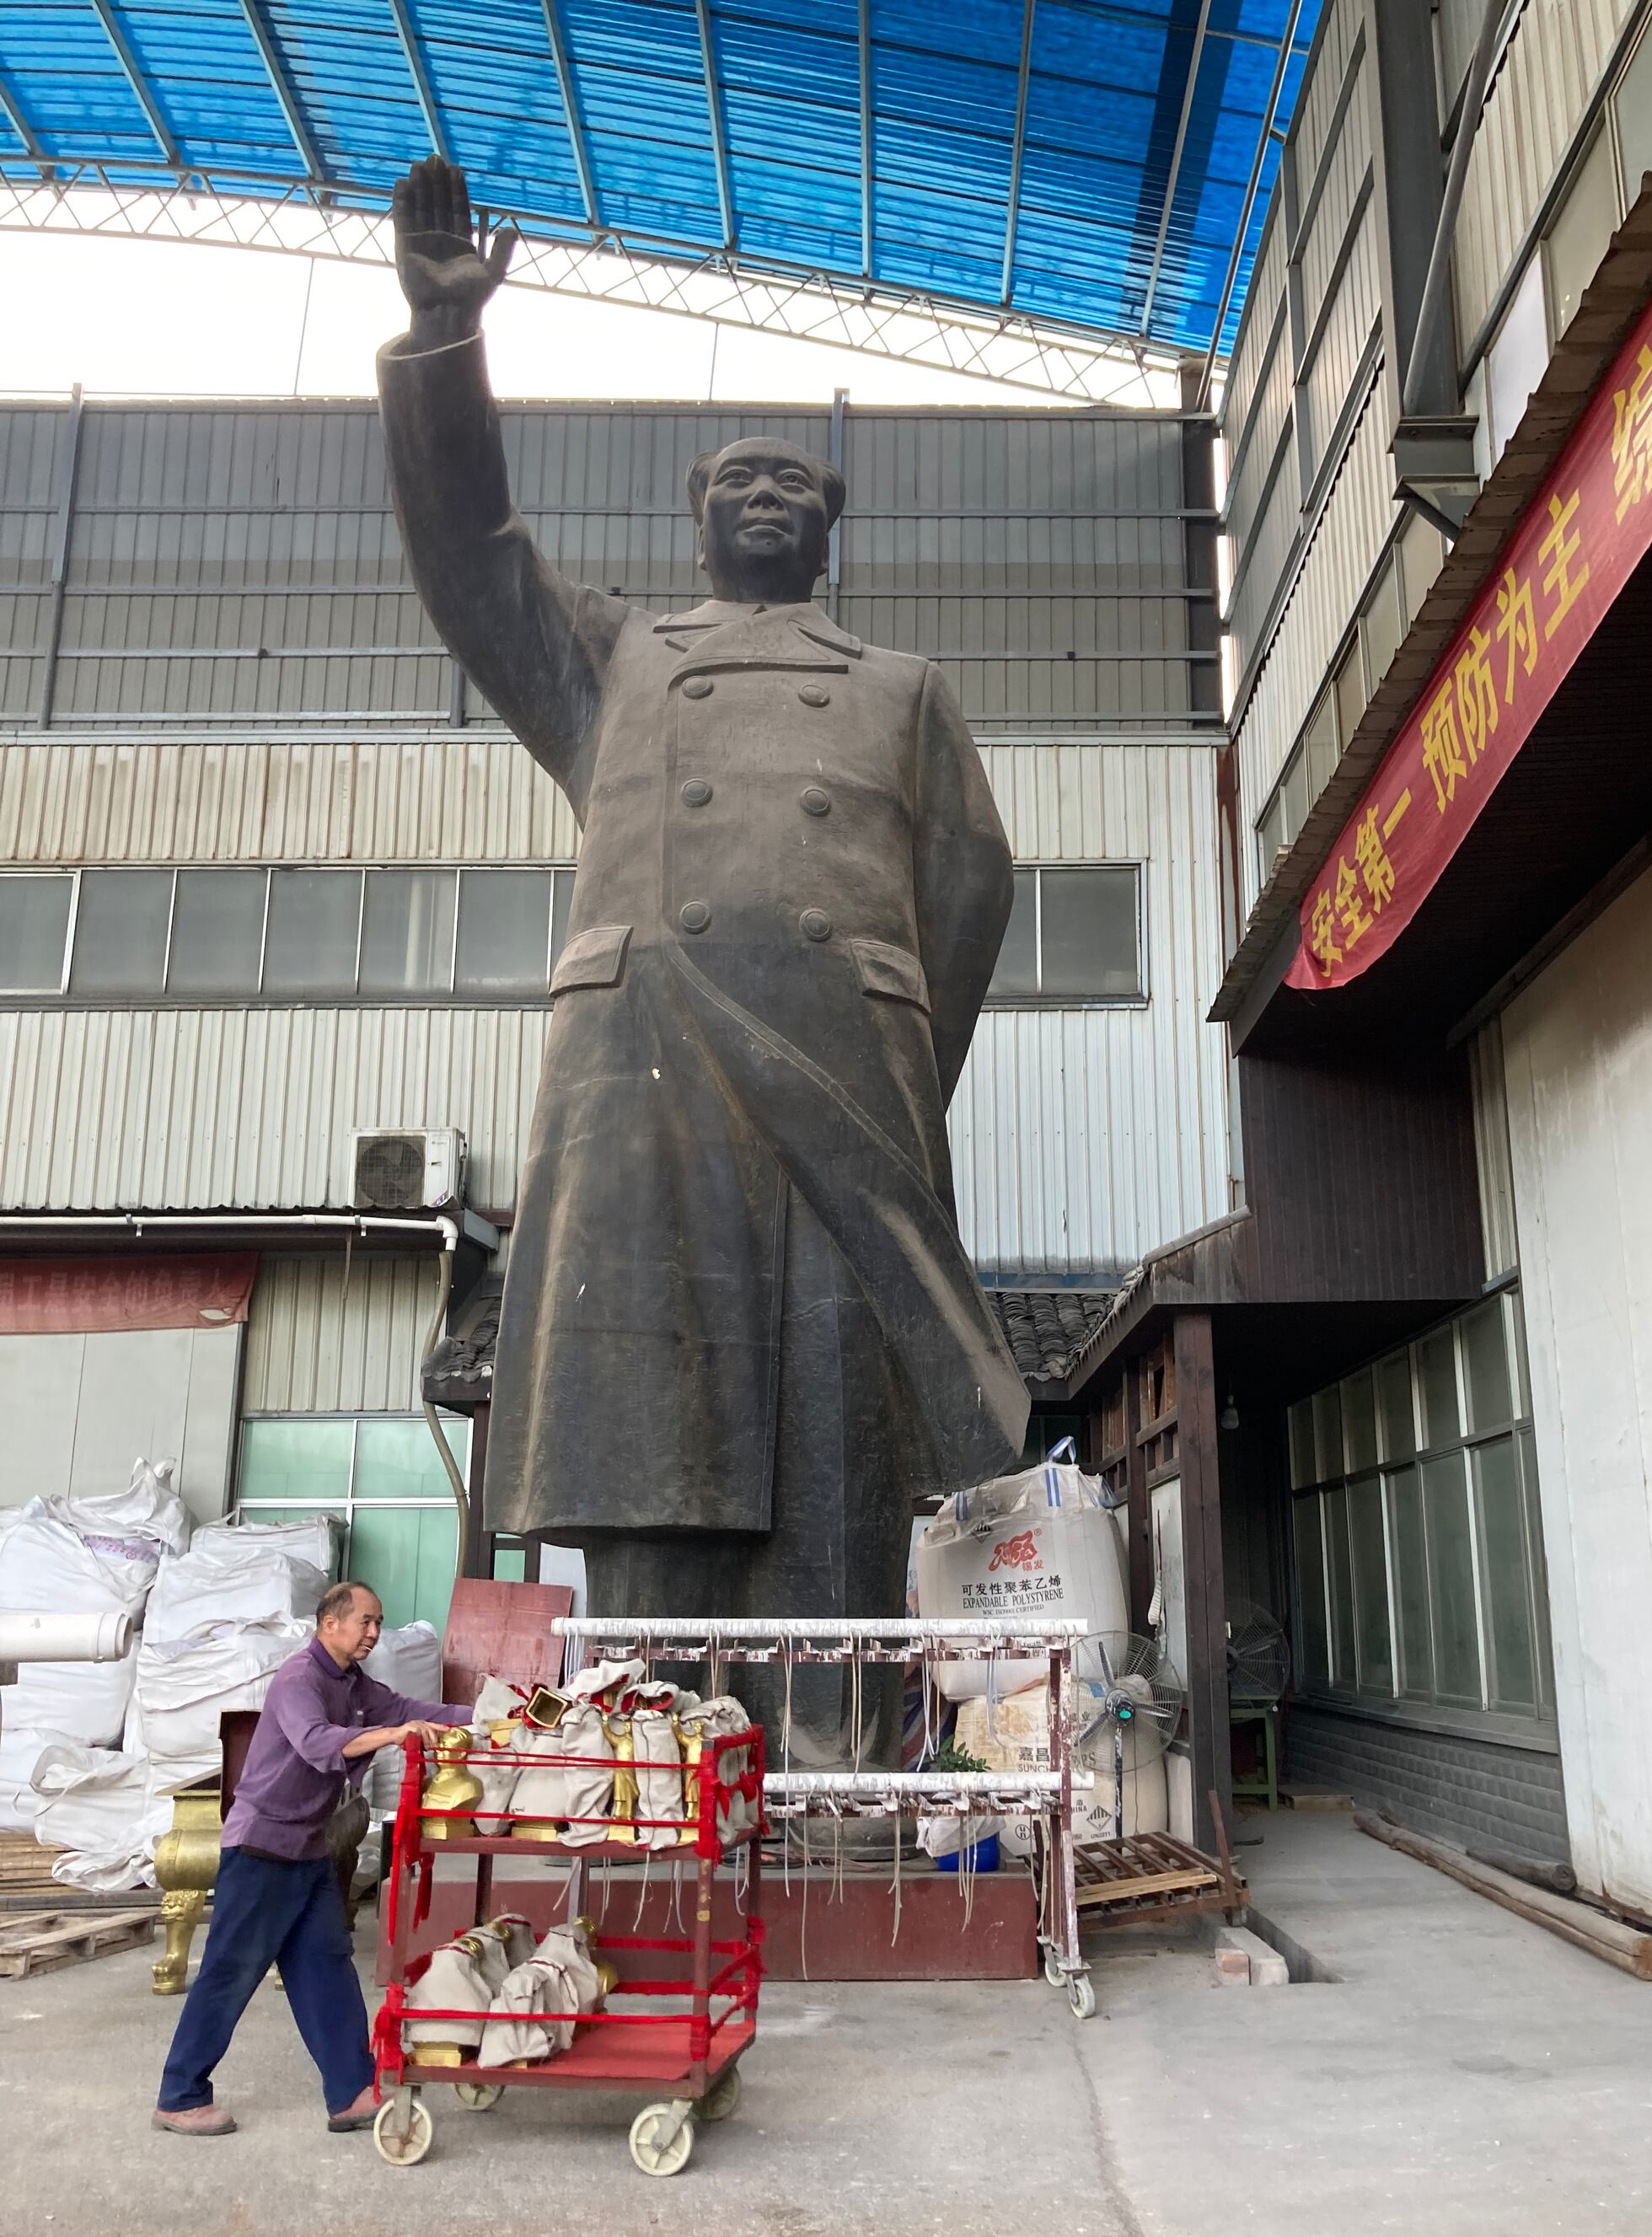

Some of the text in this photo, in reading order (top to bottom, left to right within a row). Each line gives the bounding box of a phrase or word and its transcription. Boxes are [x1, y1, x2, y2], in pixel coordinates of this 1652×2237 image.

[1311, 787, 1412, 977] 安全第一
[1420, 487, 1590, 814] 预防为主
[962, 1574, 1061, 1596] 可发性聚苯乙烯
[963, 1588, 1064, 1609] EXPANDABLE POLYSTYRENE
[1016, 1604, 1044, 1613] CERTIFIED
[1018, 1746, 1050, 1762] 嘉昌
